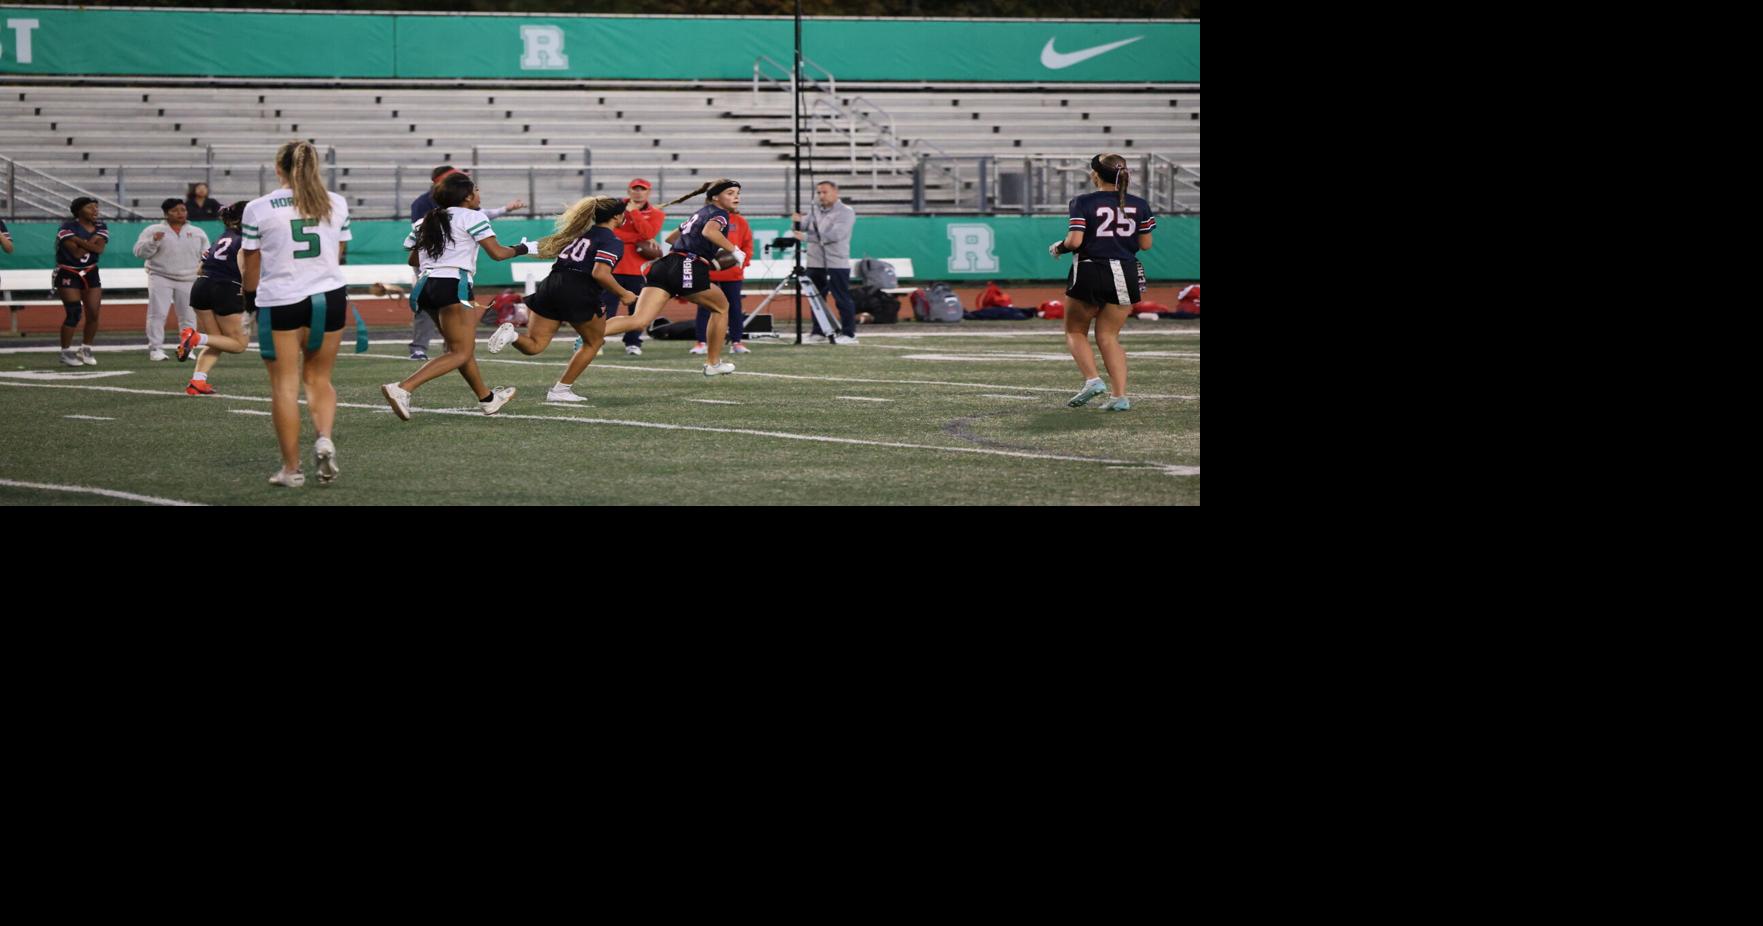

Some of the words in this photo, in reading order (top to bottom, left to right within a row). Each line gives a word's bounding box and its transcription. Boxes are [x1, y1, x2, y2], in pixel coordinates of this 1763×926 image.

[0, 18, 40, 64] T
[519, 25, 569, 70] R
[290, 218, 321, 259] 5
[1096, 206, 1137, 237] 25
[214, 237, 232, 260] 2
[559, 237, 591, 262] 20
[947, 223, 999, 273] R
